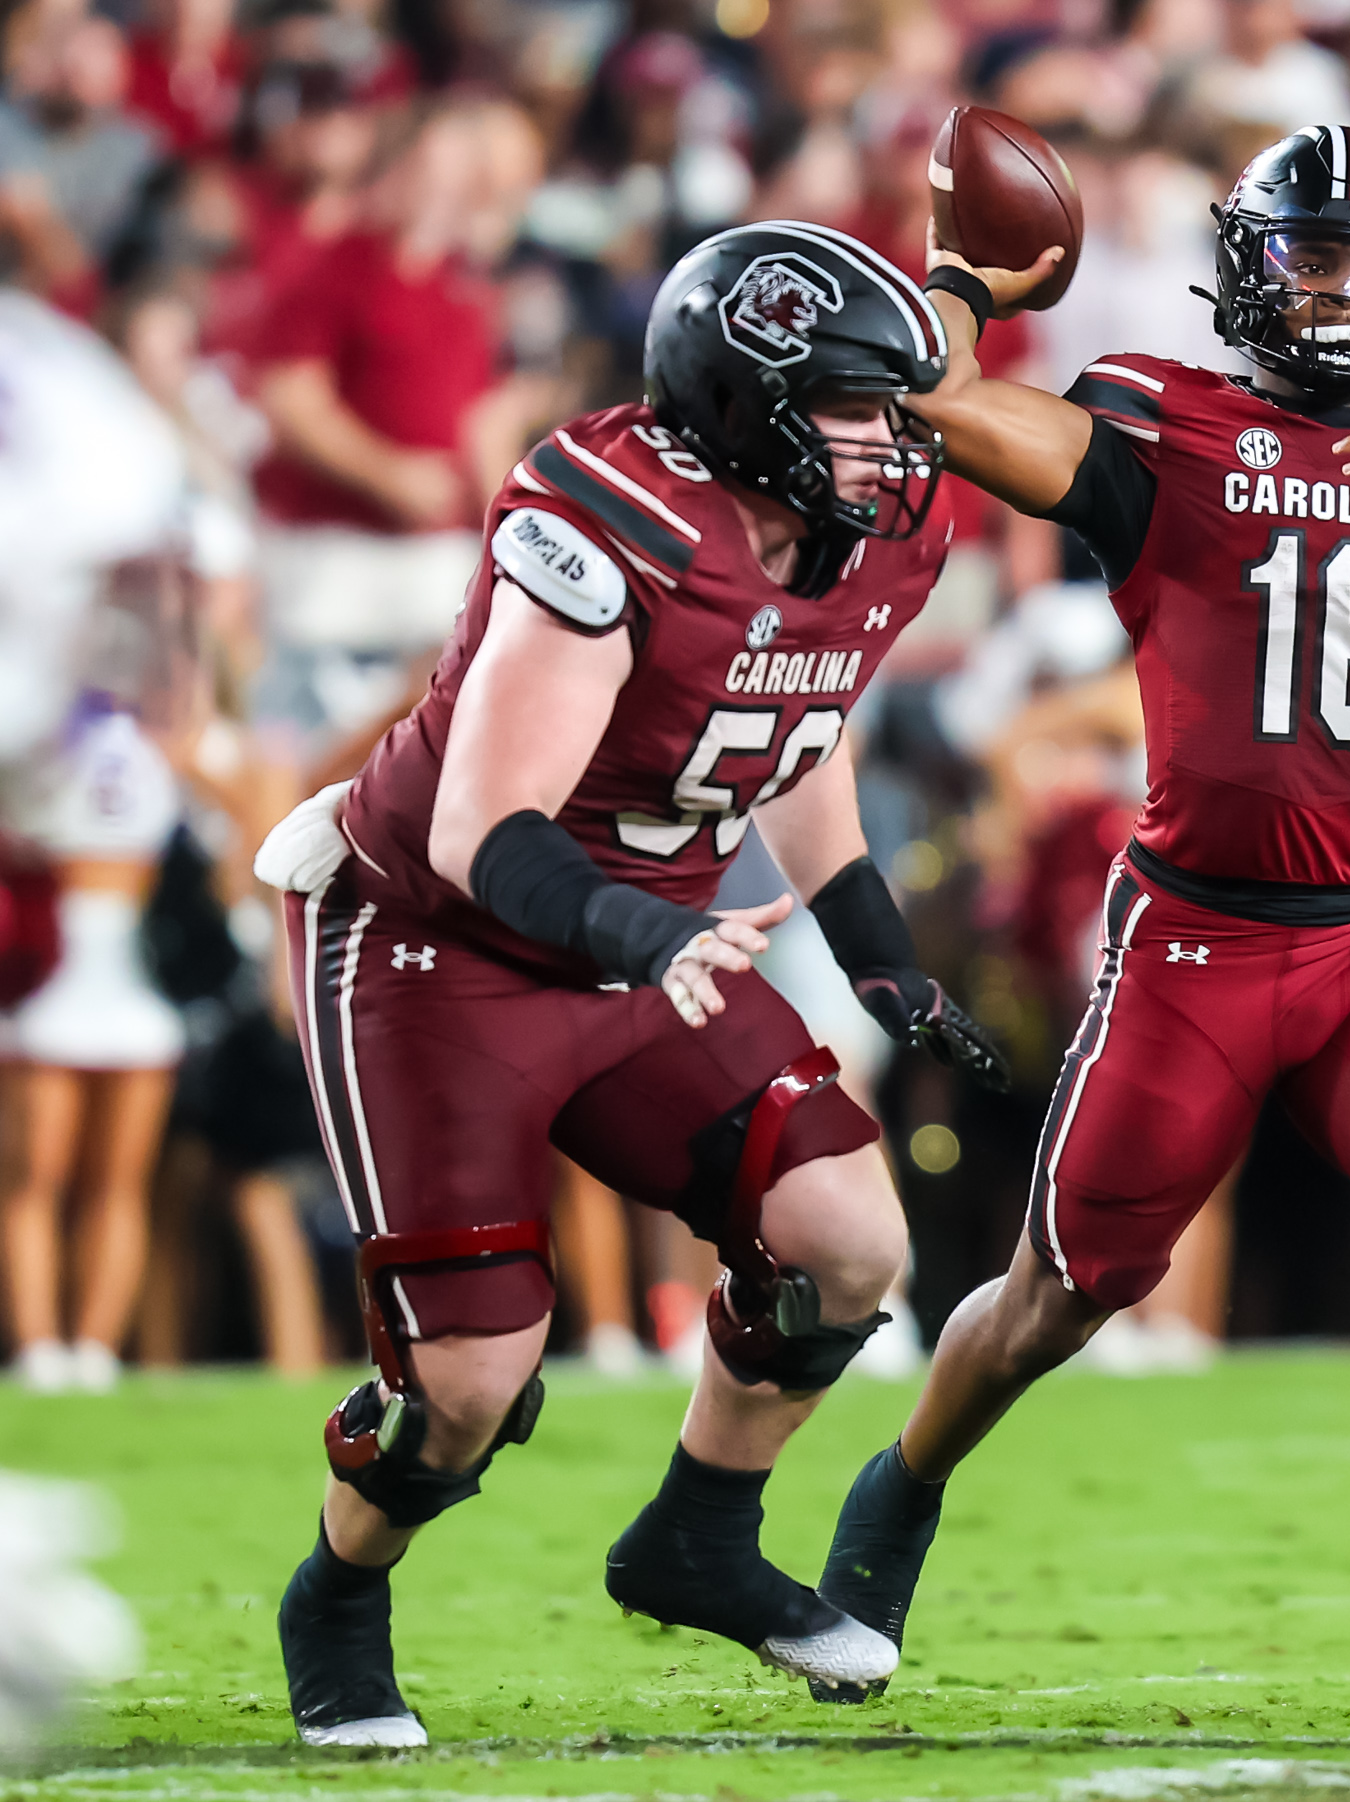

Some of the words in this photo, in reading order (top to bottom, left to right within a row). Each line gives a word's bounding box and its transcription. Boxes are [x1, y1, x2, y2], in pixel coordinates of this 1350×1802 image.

[630, 424, 713, 483] 50
[1238, 430, 1279, 467] SEC
[725, 650, 863, 694] CAROLINA
[616, 706, 843, 860] 50
